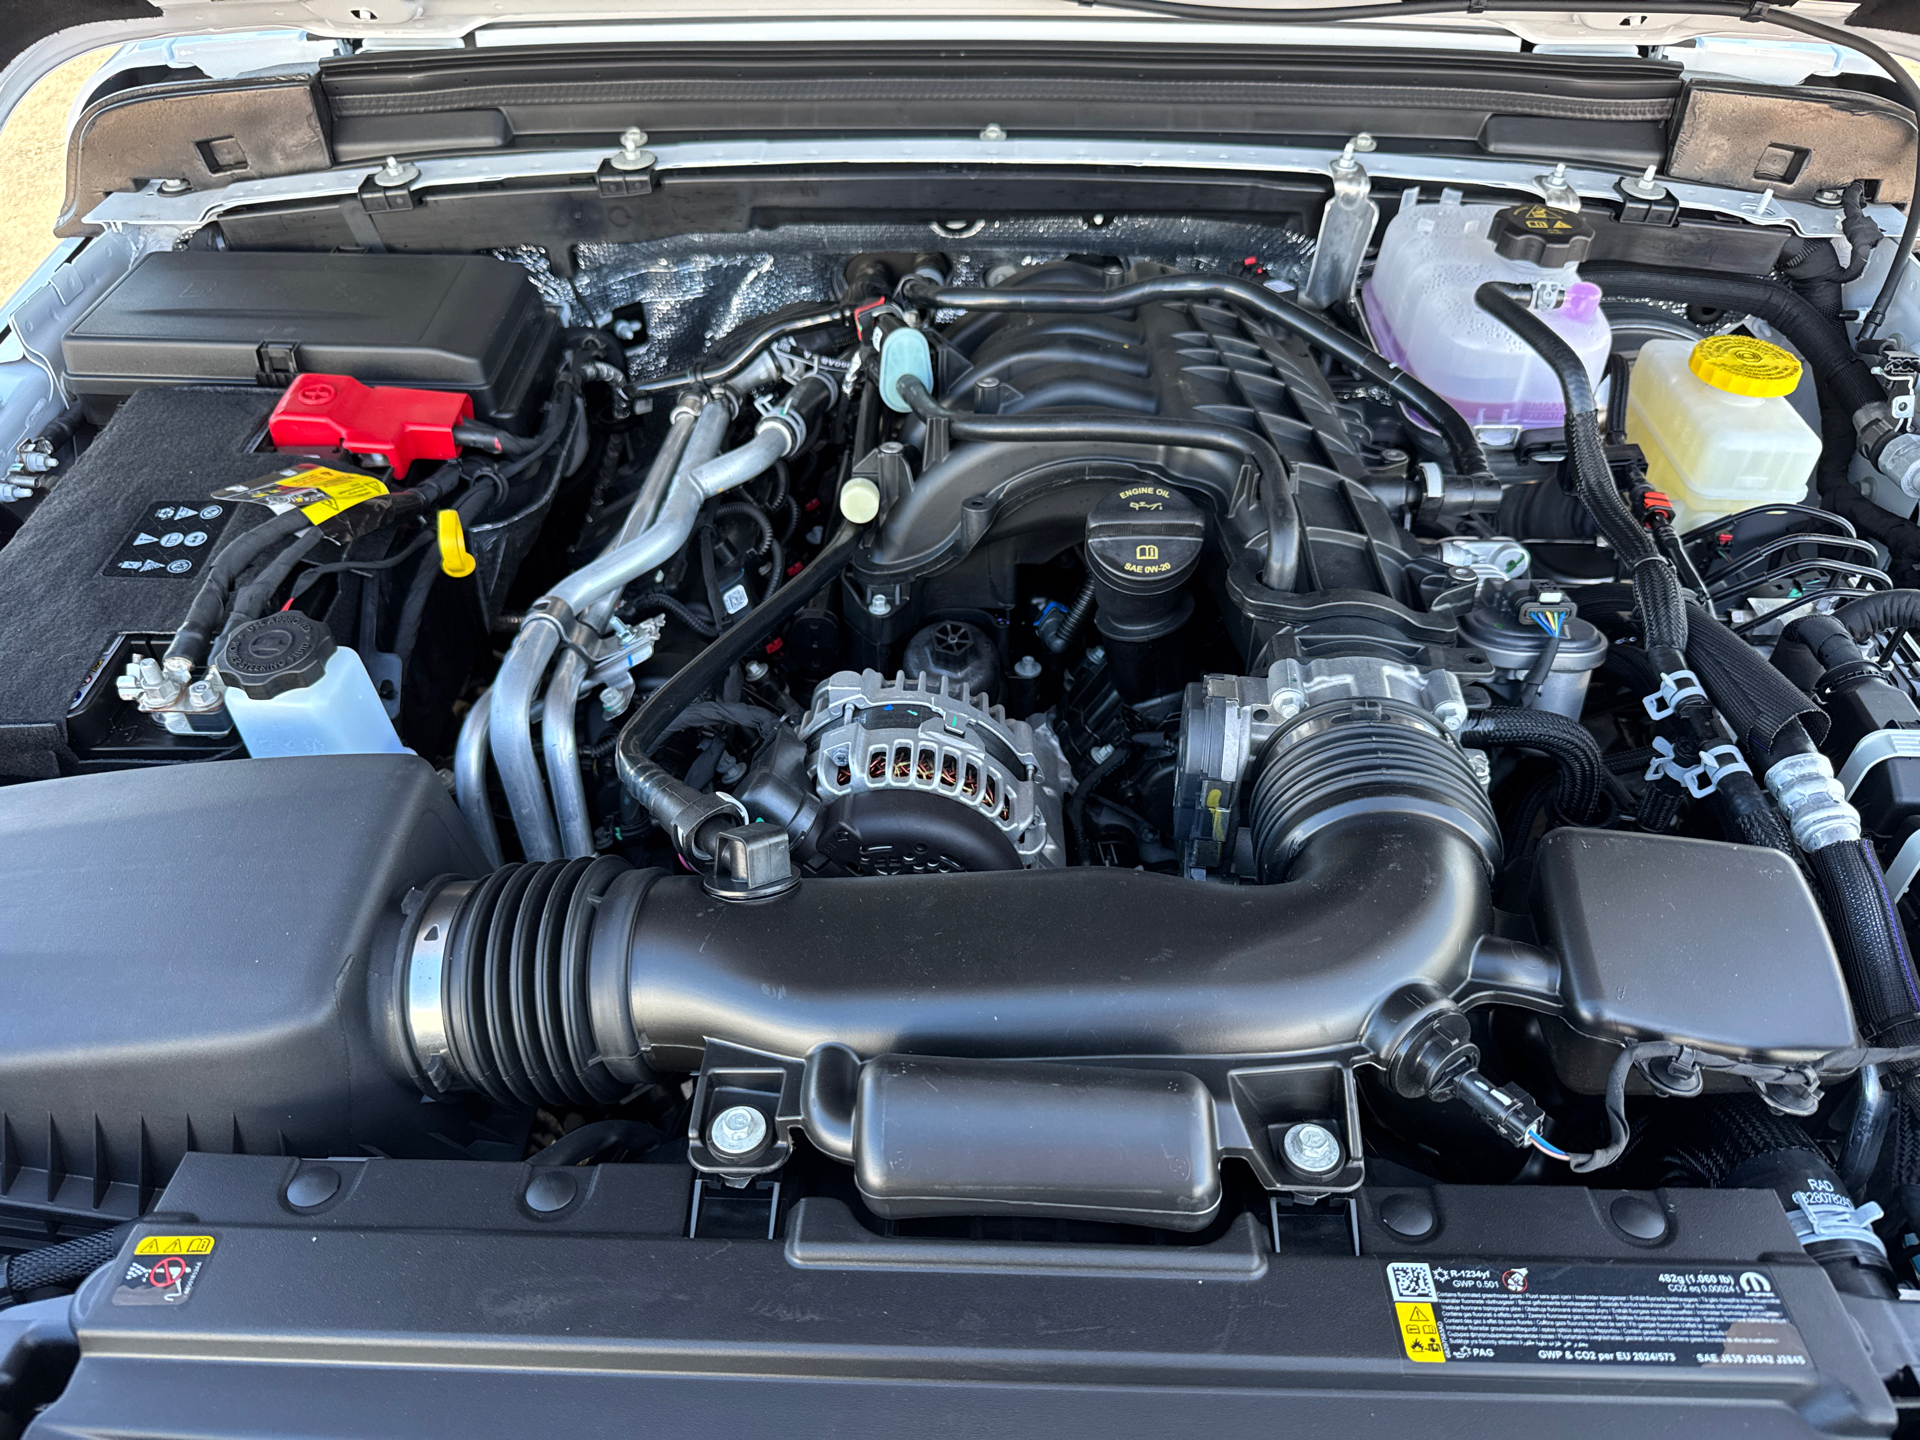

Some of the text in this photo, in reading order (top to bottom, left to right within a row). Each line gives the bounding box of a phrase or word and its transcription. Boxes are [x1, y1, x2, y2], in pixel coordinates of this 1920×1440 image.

[1119, 487, 1171, 499] ENGINE OIL
[1124, 562, 1171, 574] SAE 0W-20
[246, 615, 311, 633] USE APPROVED
[240, 659, 286, 672] STEERING
[1807, 1178, 1834, 1192] RAD
[1452, 1280, 1499, 1288] GWP 0.501
[1658, 1273, 1685, 1284] 482g
[1667, 1283, 1688, 1292] CO2
[1472, 1348, 1495, 1357] PAG
[1538, 1349, 1676, 1362] GWP & CO2 per EU 2024/573
[1696, 1353, 1719, 1363] SAE
